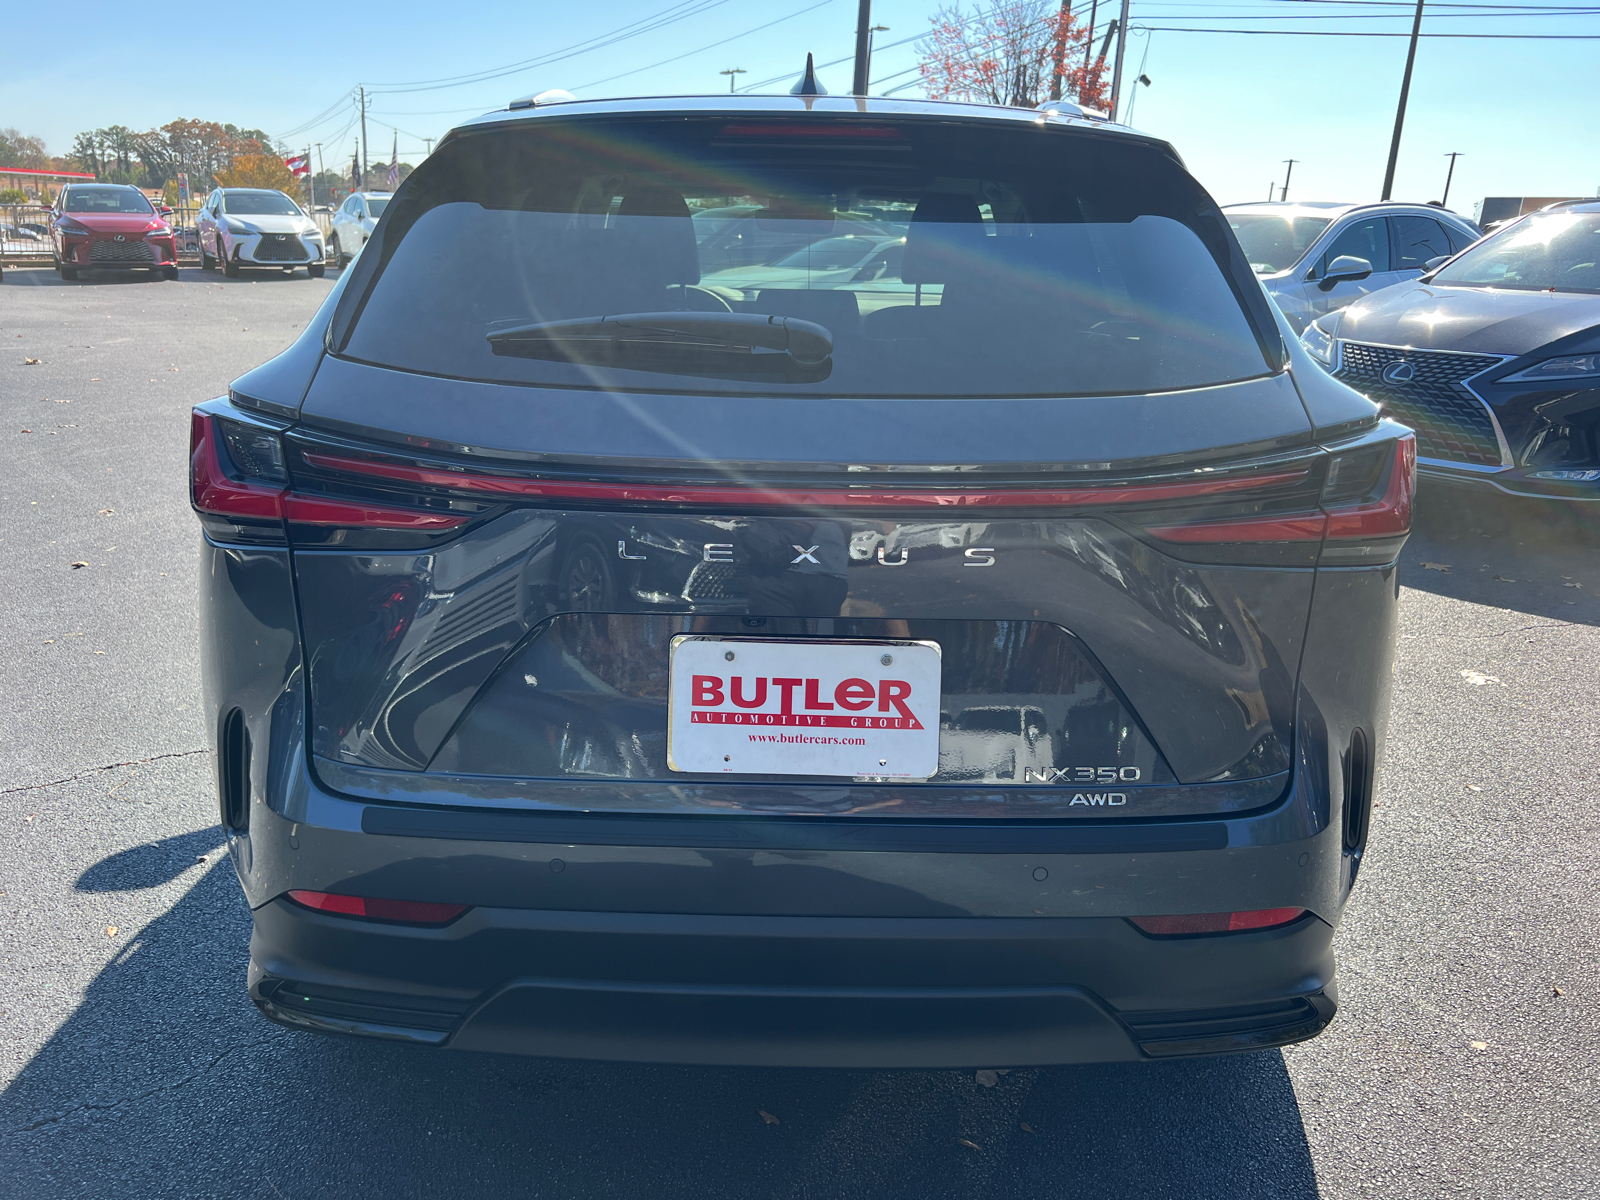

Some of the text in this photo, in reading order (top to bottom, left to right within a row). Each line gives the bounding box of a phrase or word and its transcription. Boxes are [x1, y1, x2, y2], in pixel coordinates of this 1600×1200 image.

[618, 540, 996, 567] LEXUS
[692, 713, 917, 728] AUTOMOTIVE GROUP
[748, 733, 866, 746] www.butlercars.com
[1069, 793, 1126, 806] AWD
